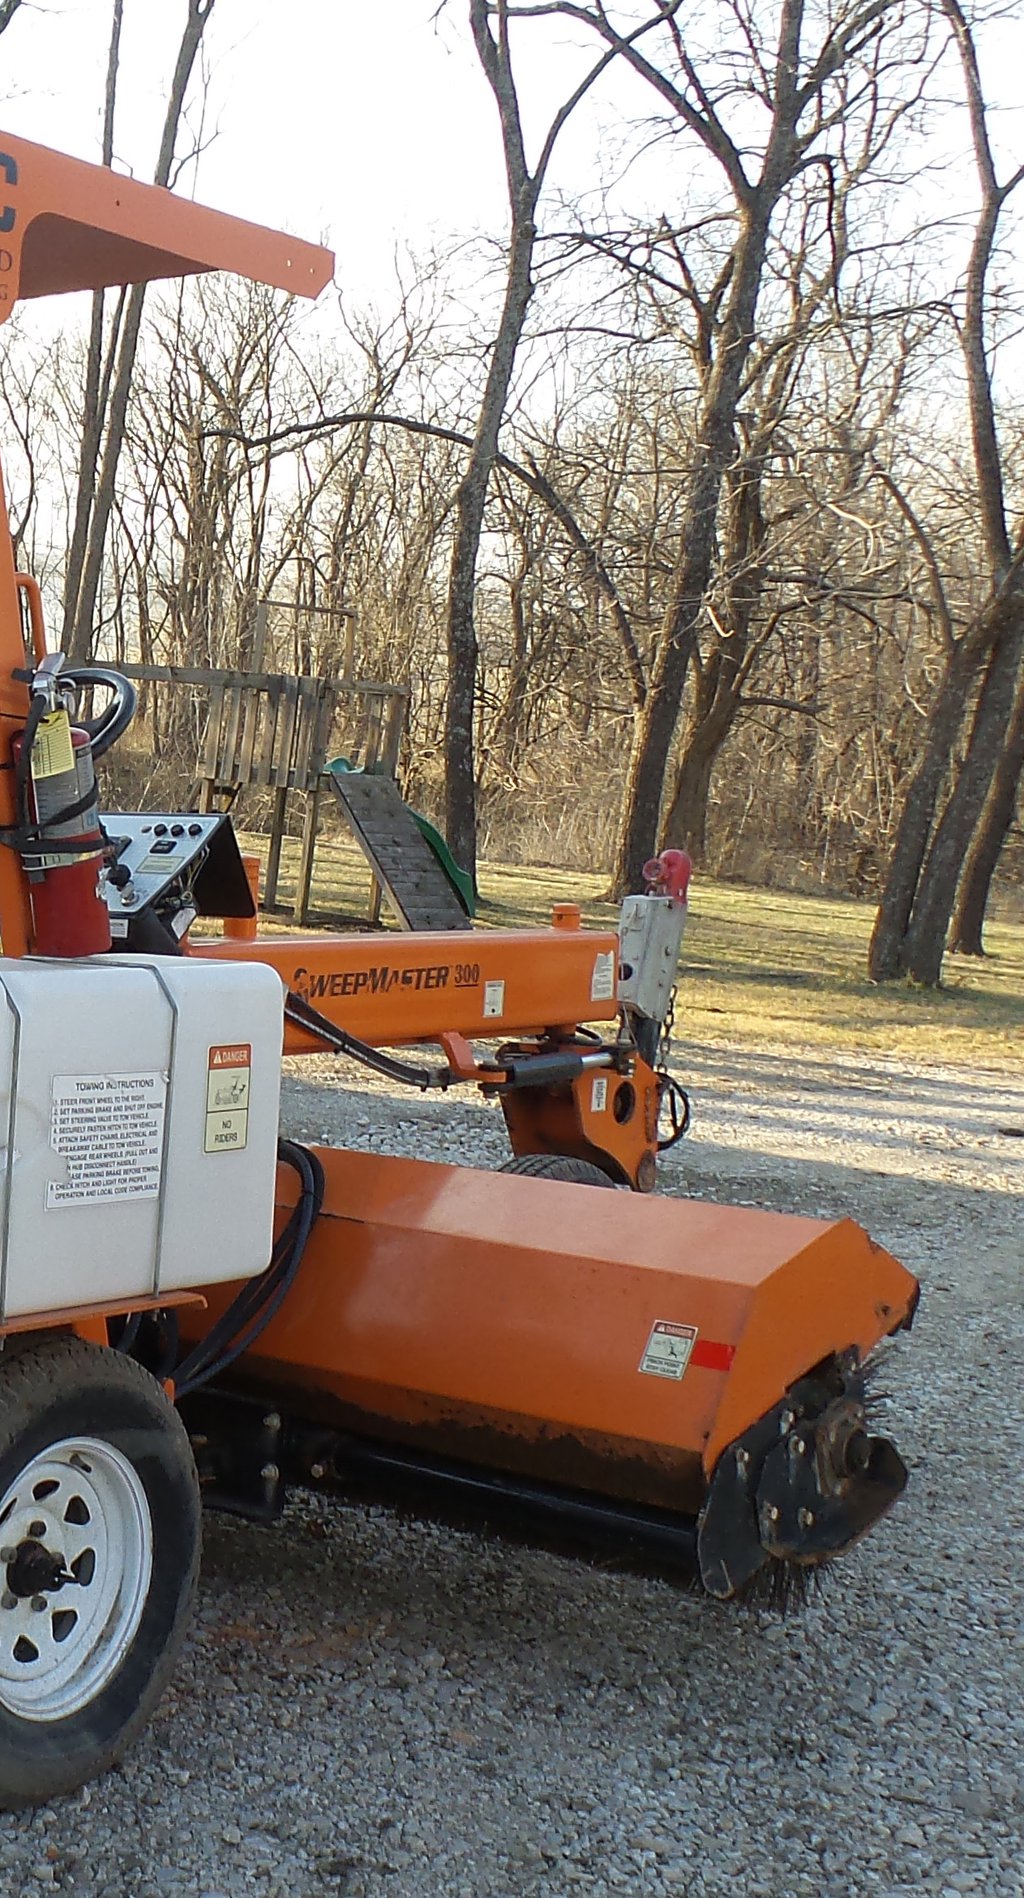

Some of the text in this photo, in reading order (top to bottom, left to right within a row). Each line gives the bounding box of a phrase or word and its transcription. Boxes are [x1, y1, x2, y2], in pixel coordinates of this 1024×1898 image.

[455, 964, 480, 984] 300
[222, 1050, 248, 1063] DANGER
[75, 1082, 104, 1091] TOWING
[222, 1120, 232, 1129] NO
[215, 1132, 238, 1143] RIDERS
